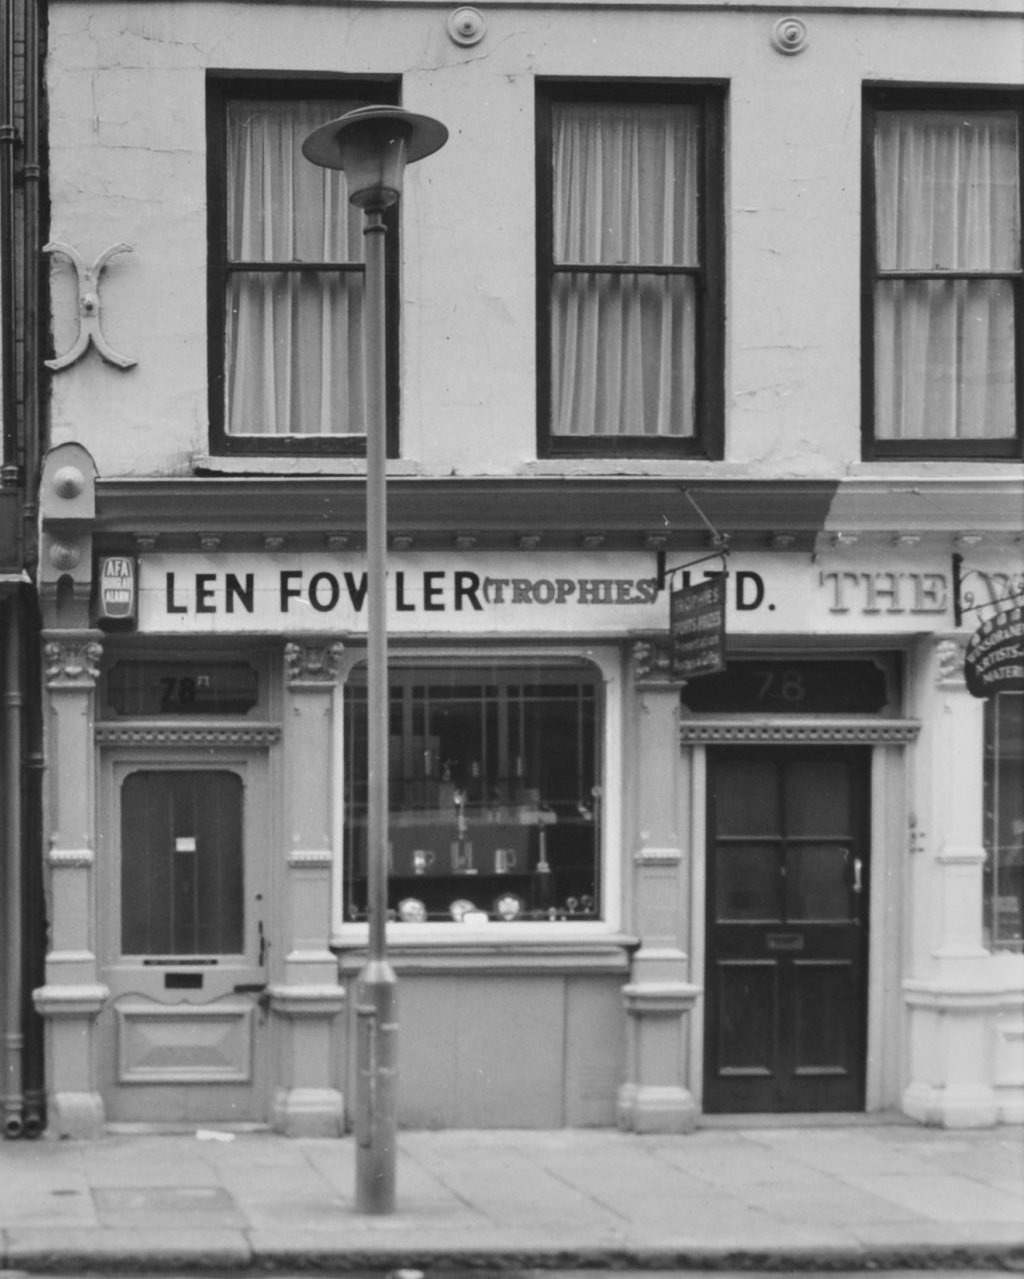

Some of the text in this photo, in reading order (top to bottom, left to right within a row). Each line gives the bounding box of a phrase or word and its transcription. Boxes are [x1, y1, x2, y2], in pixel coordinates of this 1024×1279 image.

[106, 560, 129, 577] AFA
[166, 572, 254, 614] LEN
[280, 570, 483, 612] FOWLER
[483, 576, 658, 606] (TROPHIES)
[819, 571, 947, 616] THE
[751, 670, 806, 702] 78
